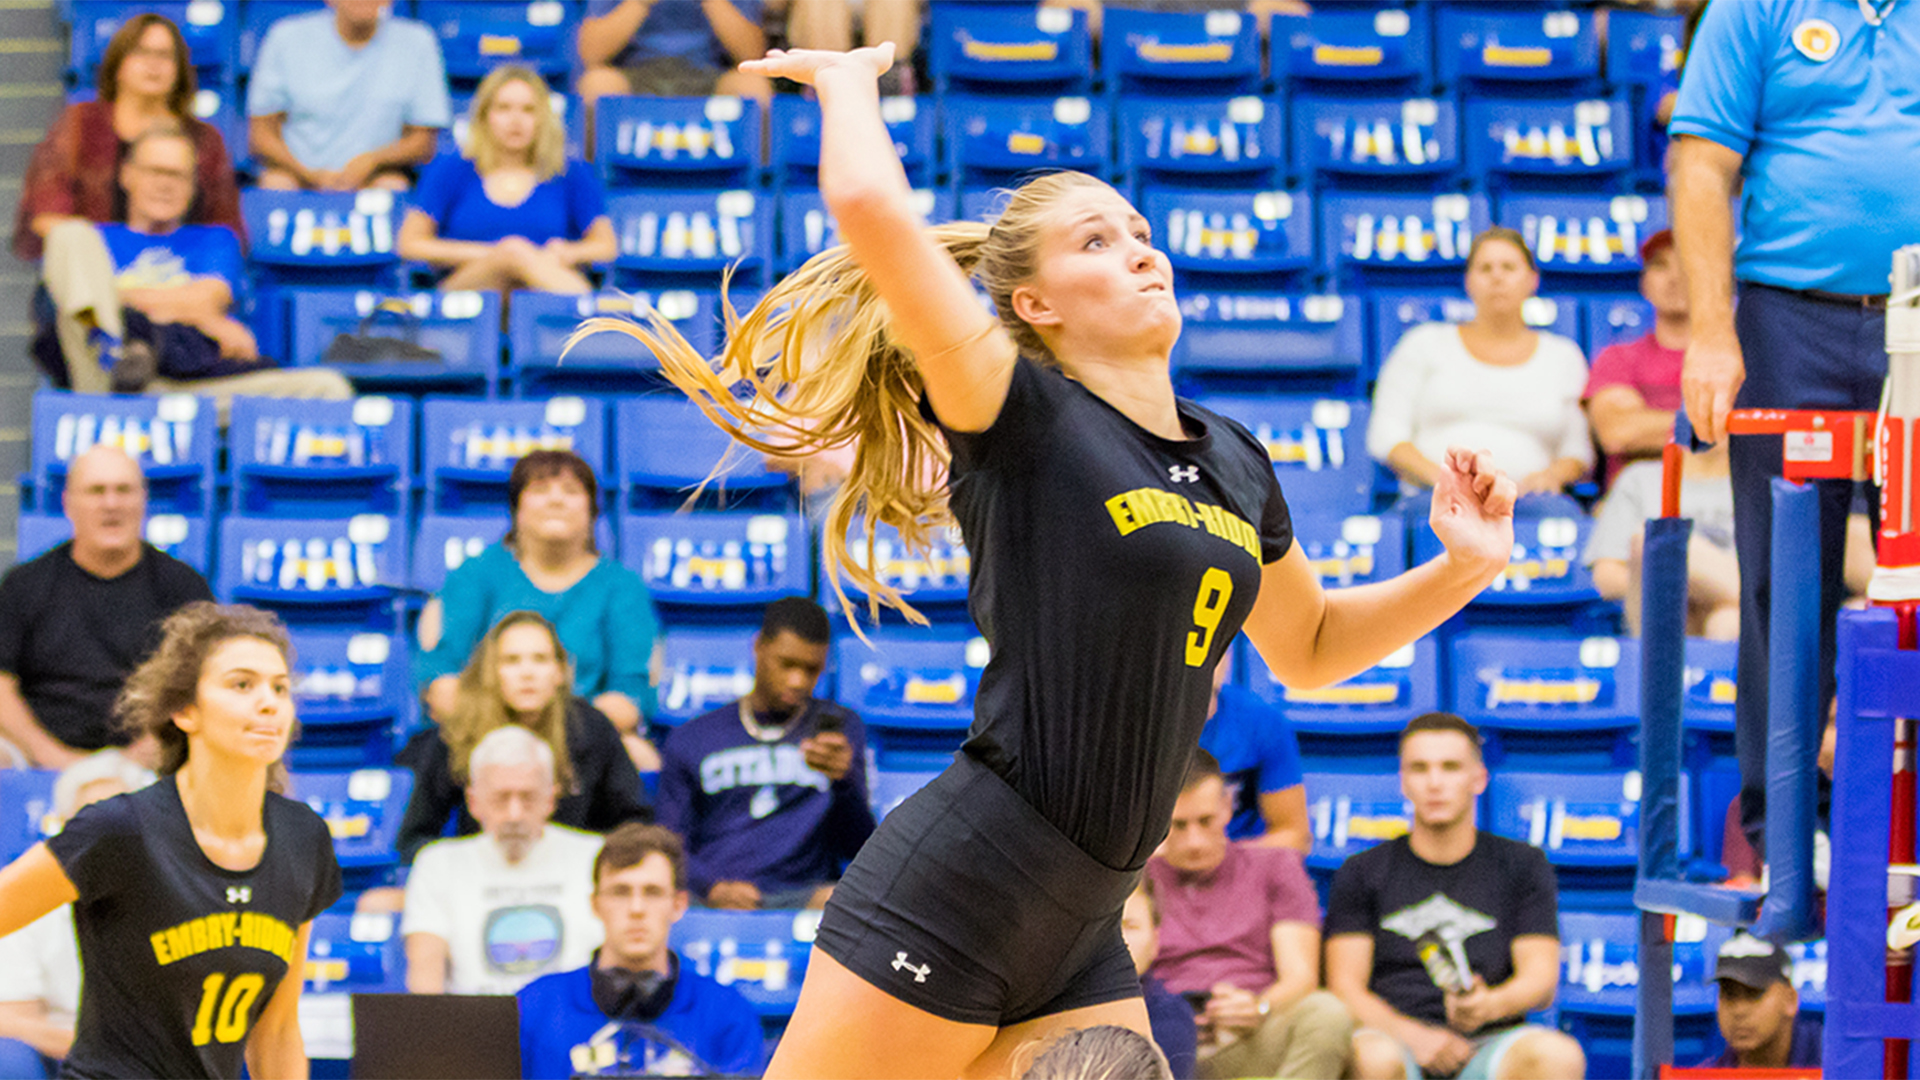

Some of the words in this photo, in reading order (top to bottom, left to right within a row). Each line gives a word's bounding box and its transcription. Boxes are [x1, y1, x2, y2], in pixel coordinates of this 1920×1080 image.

[1104, 487, 1262, 568] EMBRY-RIDD
[1185, 566, 1234, 667] 9
[191, 972, 265, 1046] 10
